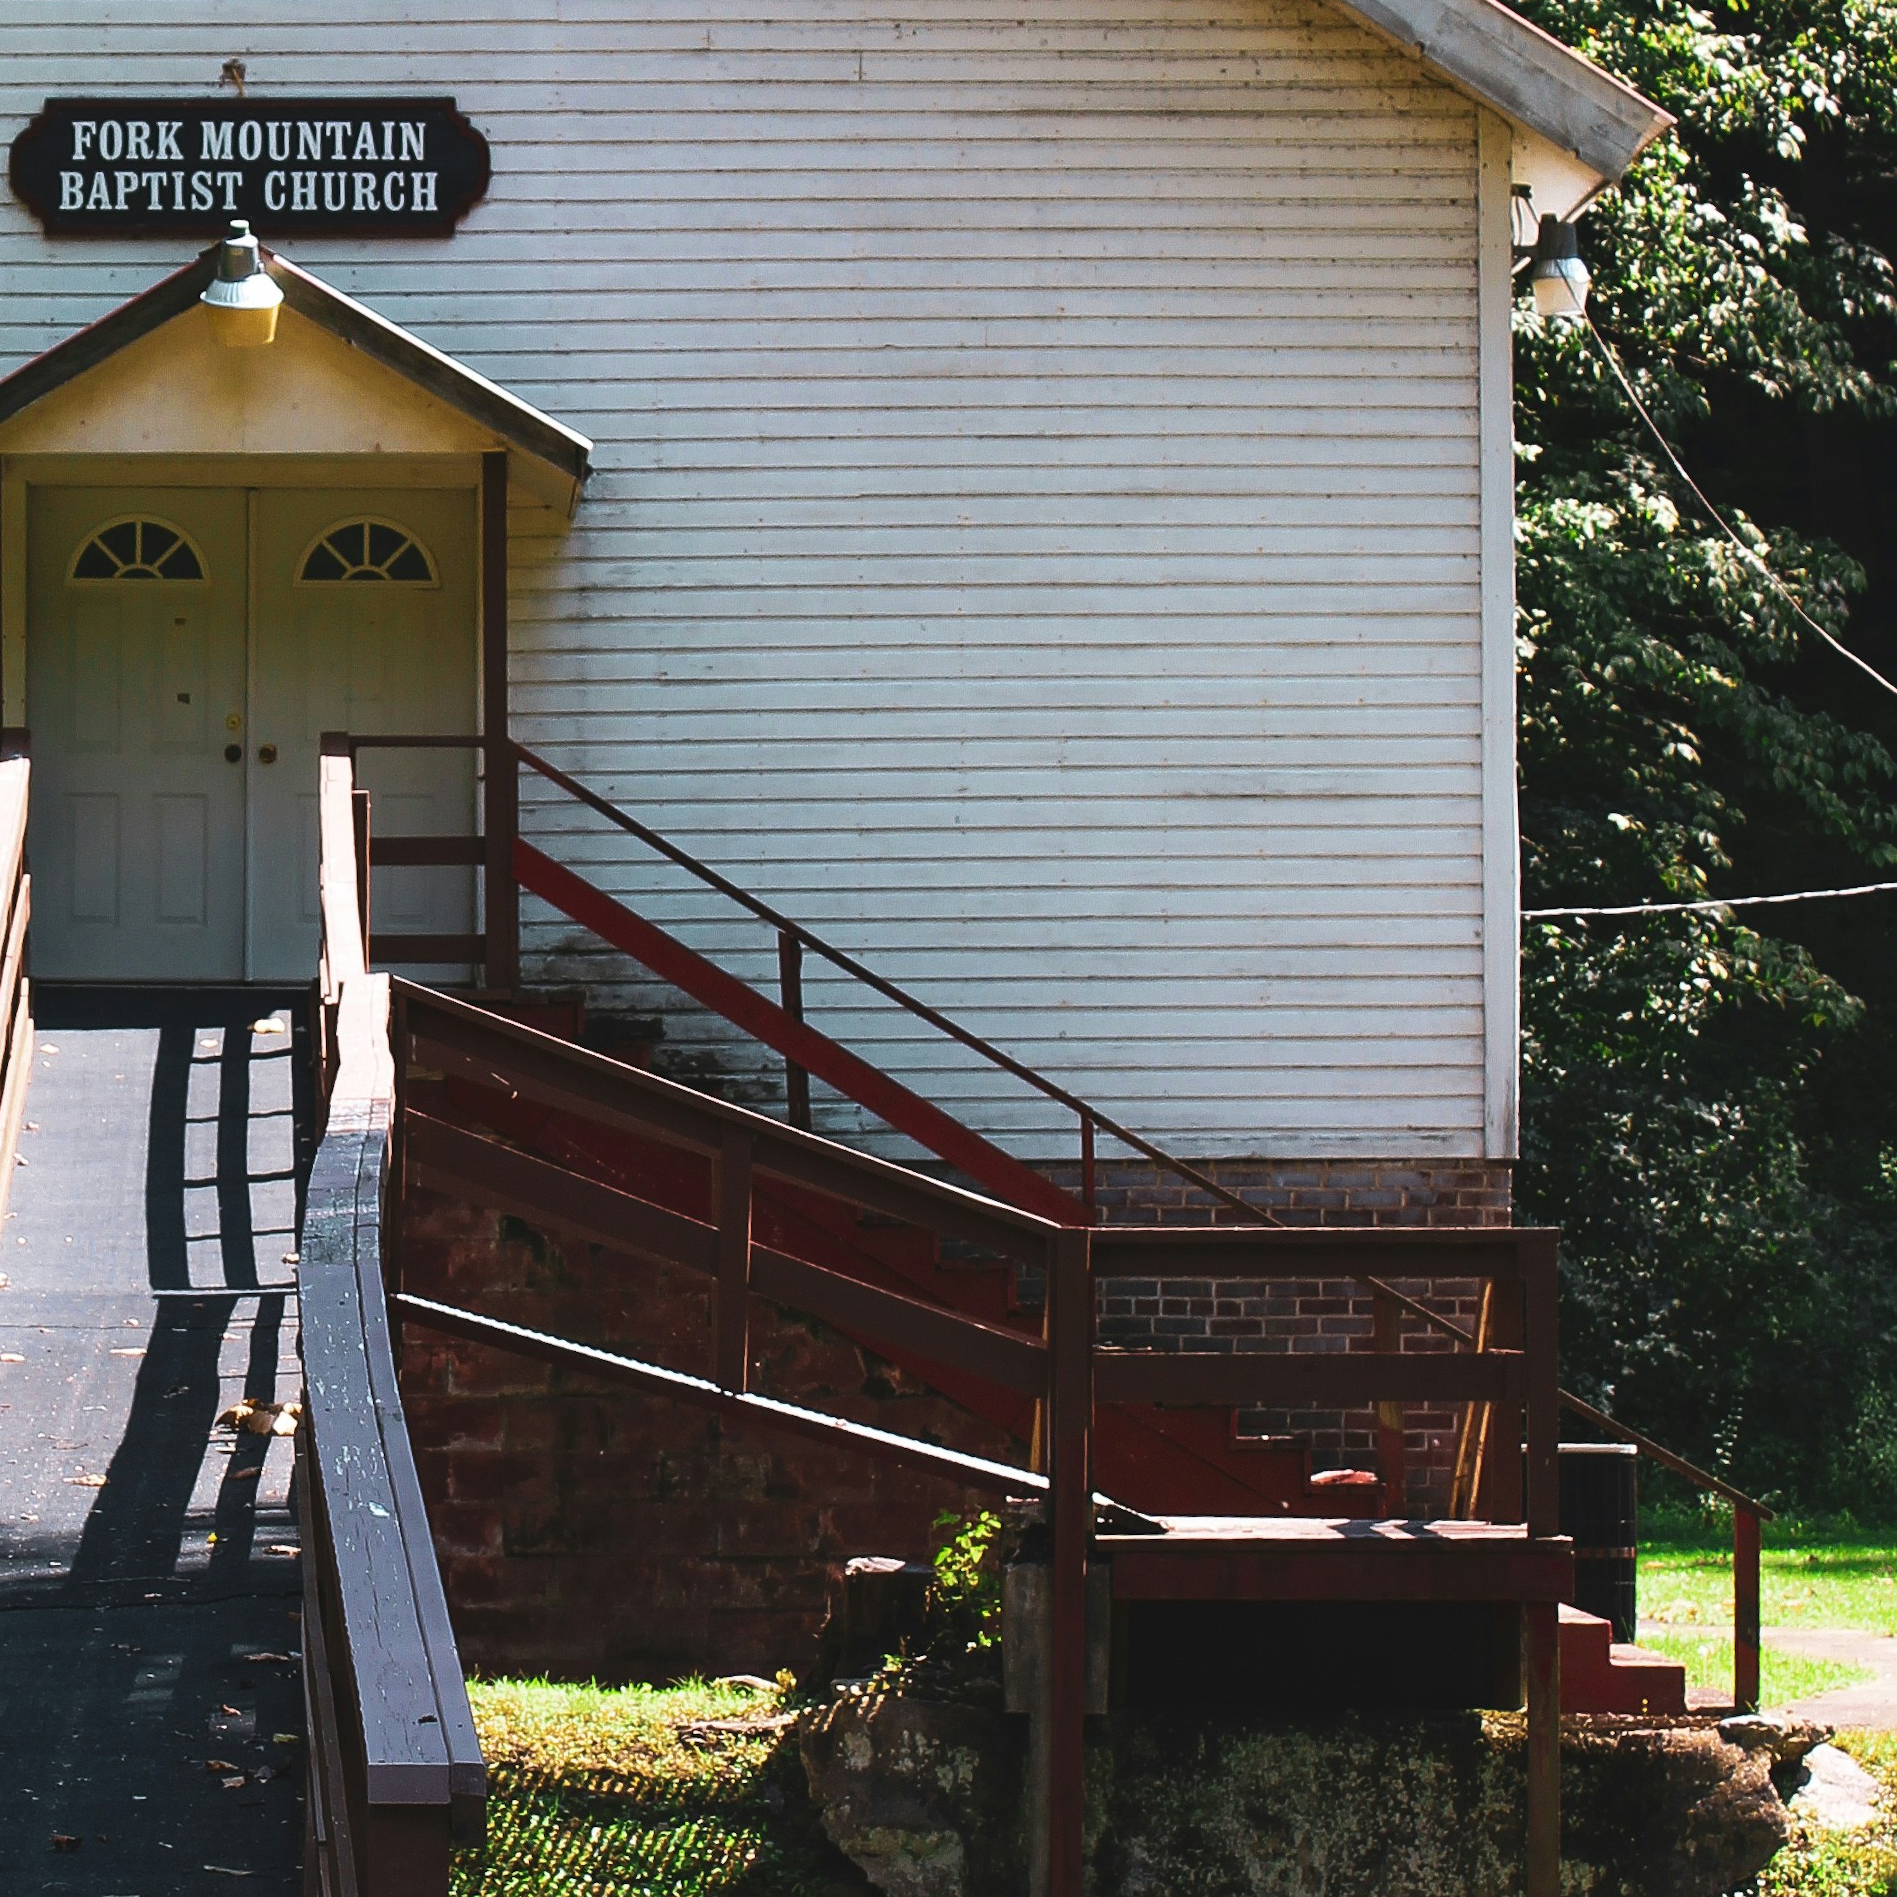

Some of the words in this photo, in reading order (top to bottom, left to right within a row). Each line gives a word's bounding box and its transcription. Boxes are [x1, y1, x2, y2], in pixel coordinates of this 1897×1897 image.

[71, 120, 184, 161] FORK
[199, 120, 426, 161] MOUNTAIN
[59, 170, 243, 211] BAPTIST
[264, 170, 438, 212] CHURCH
